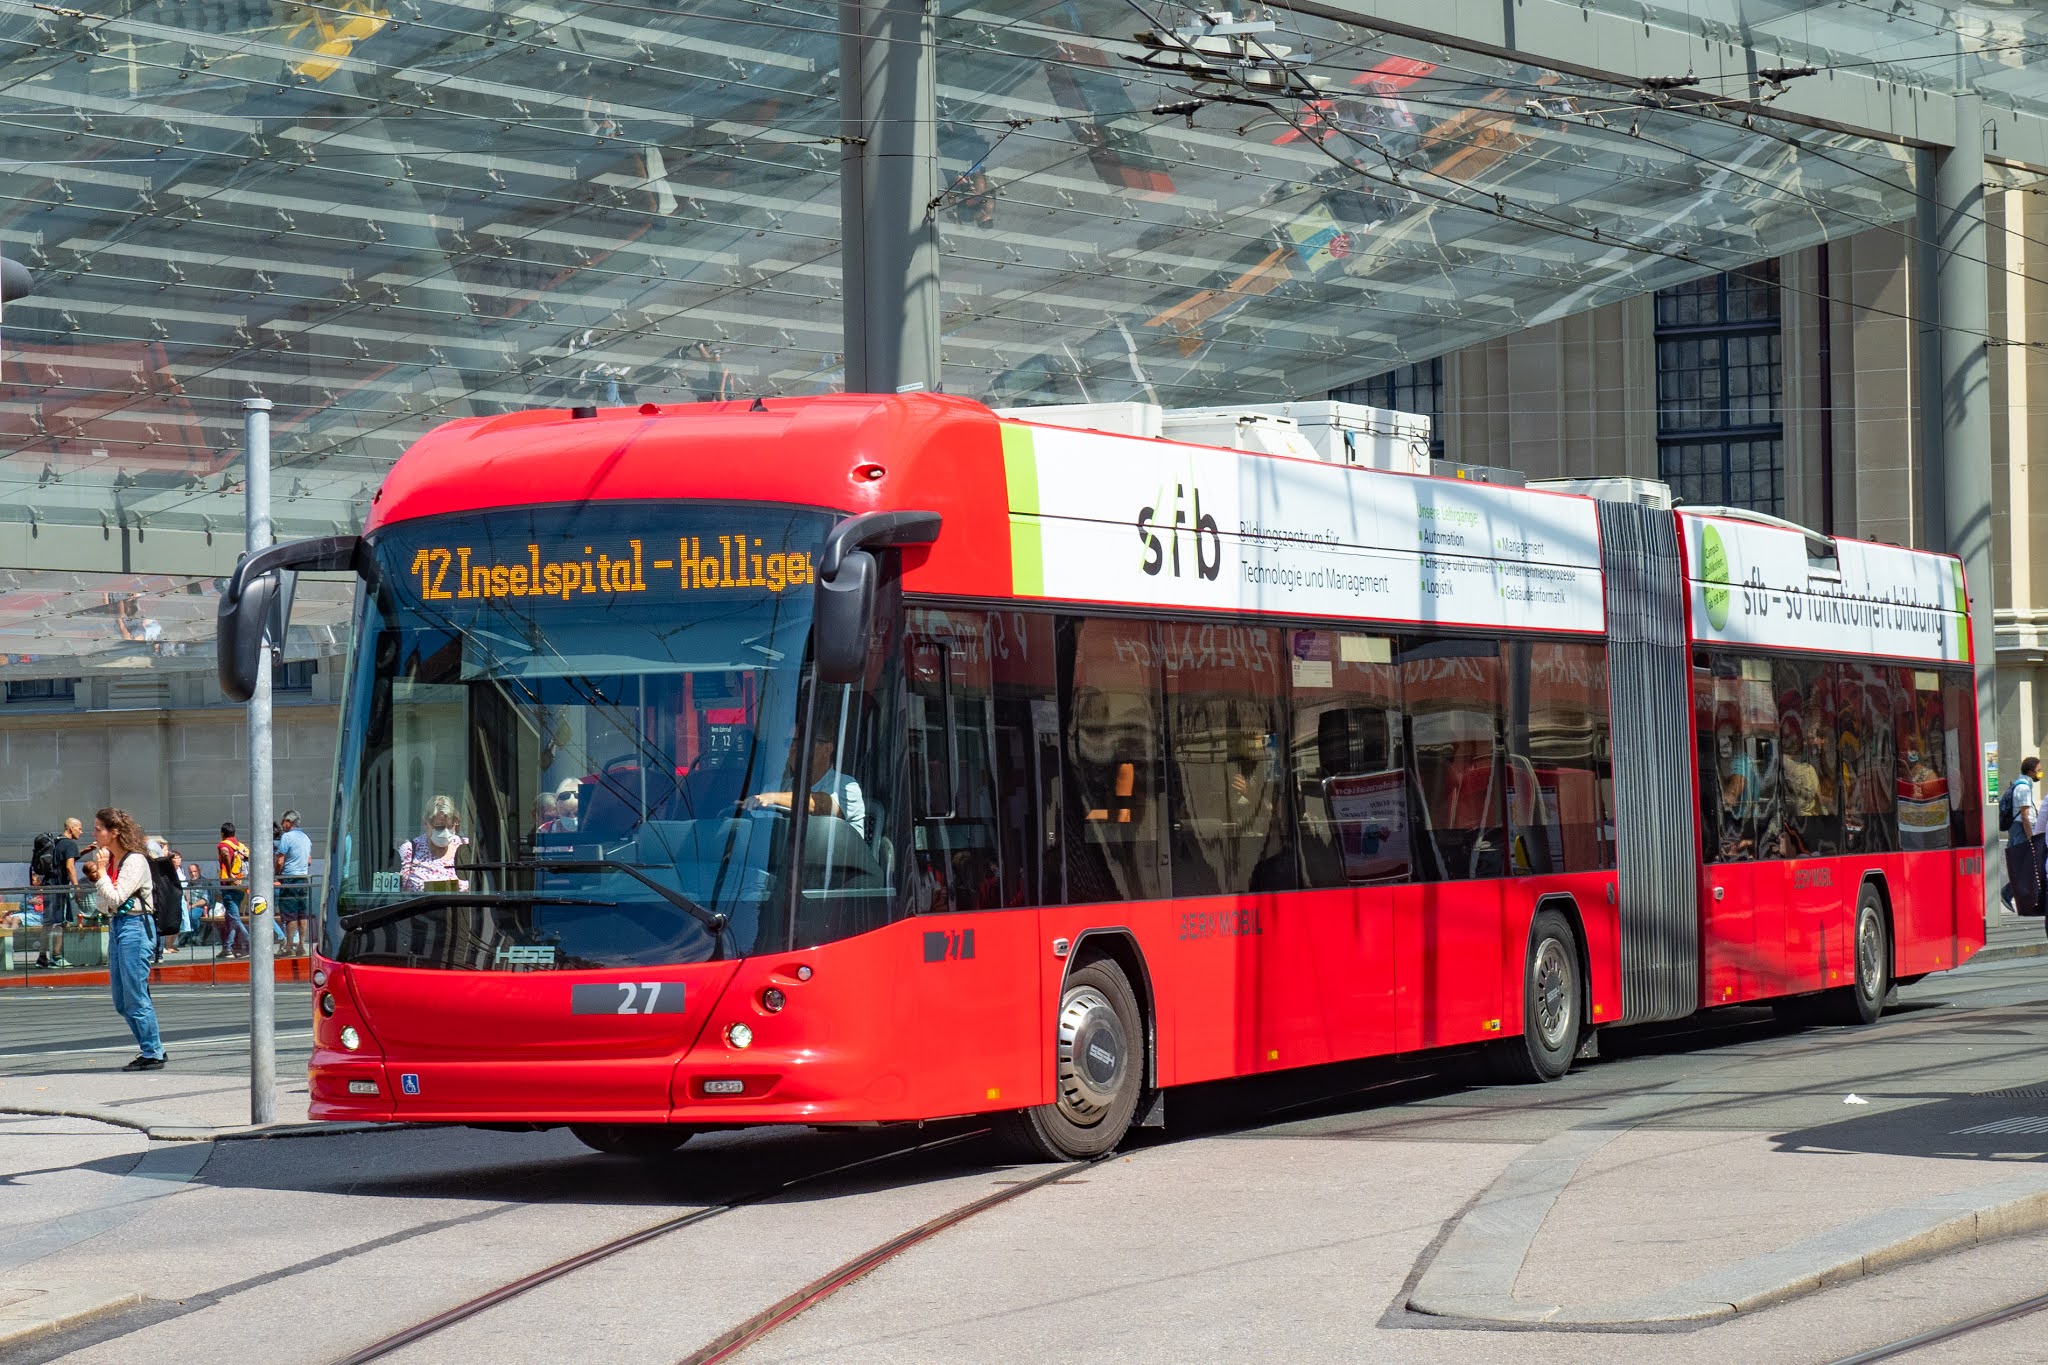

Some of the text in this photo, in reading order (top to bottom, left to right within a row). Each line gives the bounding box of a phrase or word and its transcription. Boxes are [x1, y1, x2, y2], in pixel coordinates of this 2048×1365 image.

[1416, 503, 1440, 520] Unsere
[1138, 483, 1221, 582] sfb
[1239, 521, 1340, 552] Bildungszentrum für
[1424, 528, 1465, 547] Automation
[1502, 537, 1545, 557] Management
[411, 548, 452, 600] 12
[457, 539, 646, 600] Inselspital
[1425, 554, 1495, 574] Energie und Umwelt
[1504, 563, 1576, 584] Unternehmensprozesse
[1241, 560, 1389, 597] Technologie und Management
[1426, 578, 1454, 598] Logistik
[1506, 585, 1566, 604] Gebäudeinformatik
[1743, 566, 1768, 617] sfb
[1785, 585, 1801, 620] so
[1807, 574, 1892, 630] funktioniert
[1893, 585, 1943, 646] bildung
[495, 945, 556, 964] HESS
[617, 982, 662, 1015] 27
